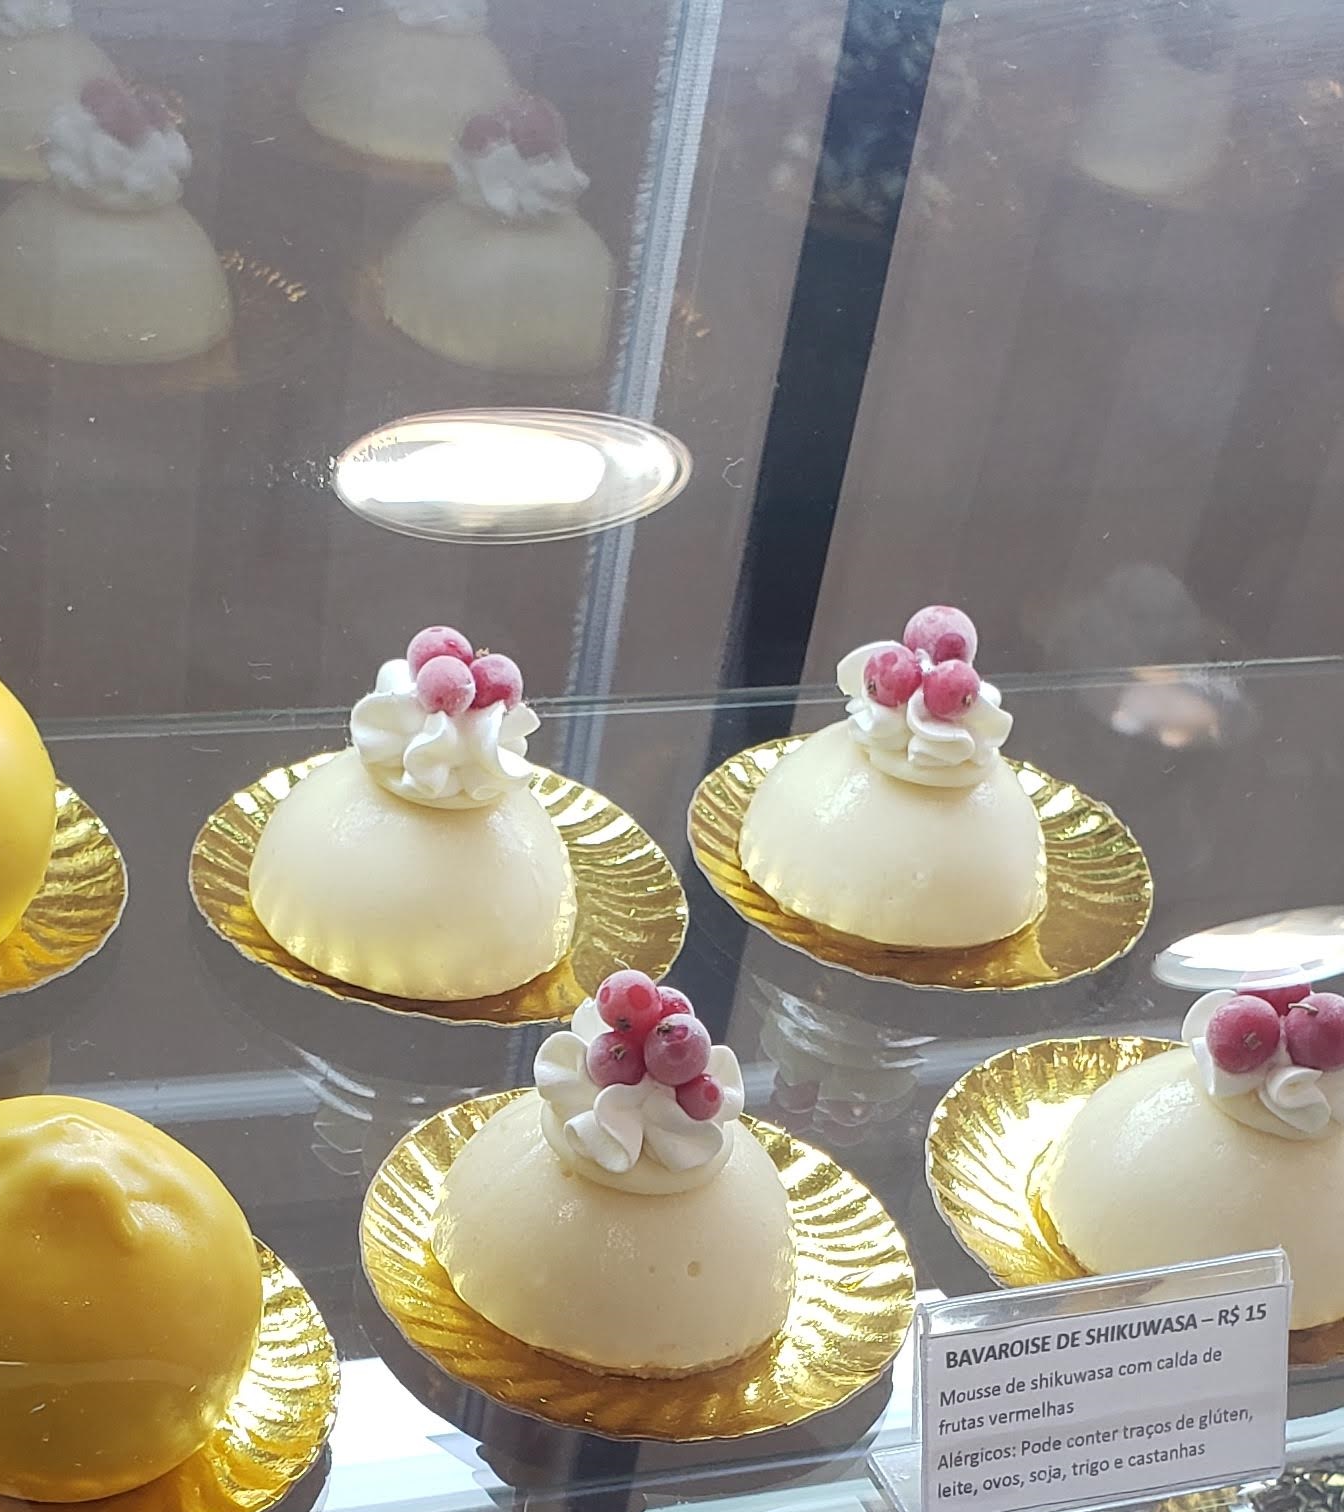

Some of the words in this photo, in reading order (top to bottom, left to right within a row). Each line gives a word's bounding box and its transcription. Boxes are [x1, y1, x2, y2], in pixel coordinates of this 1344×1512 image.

[946, 1336, 1051, 1368] BAVAROISE
[1057, 1331, 1081, 1349] DE
[1085, 1314, 1197, 1345] SHIKUWASA
[1218, 1305, 1239, 1326] R$
[1246, 1303, 1266, 1321] 15
[941, 1386, 1000, 1407] Mousse
[1006, 1377, 1025, 1393] de
[1031, 1367, 1113, 1390] shikuwasa
[1119, 1361, 1152, 1376] com
[1157, 1351, 1197, 1370] calda
[1203, 1347, 1221, 1363] de
[938, 1447, 1016, 1470] Alérgicos:
[1022, 1436, 1061, 1456] Pode
[1067, 1429, 1118, 1448] conter
[1124, 1422, 1171, 1439] traços
[1176, 1414, 1194, 1430] de
[1199, 1408, 1252, 1429] glúten,
[939, 1417, 984, 1435] frutas
[989, 1401, 1074, 1425] vermelhas
[938, 1481, 977, 1498] leite,
[983, 1475, 1024, 1490] ovos,
[1029, 1465, 1066, 1483] soja,
[1072, 1459, 1109, 1476] trigo
[1114, 1458, 1123, 1469] e
[1128, 1443, 1205, 1466] castanhas
